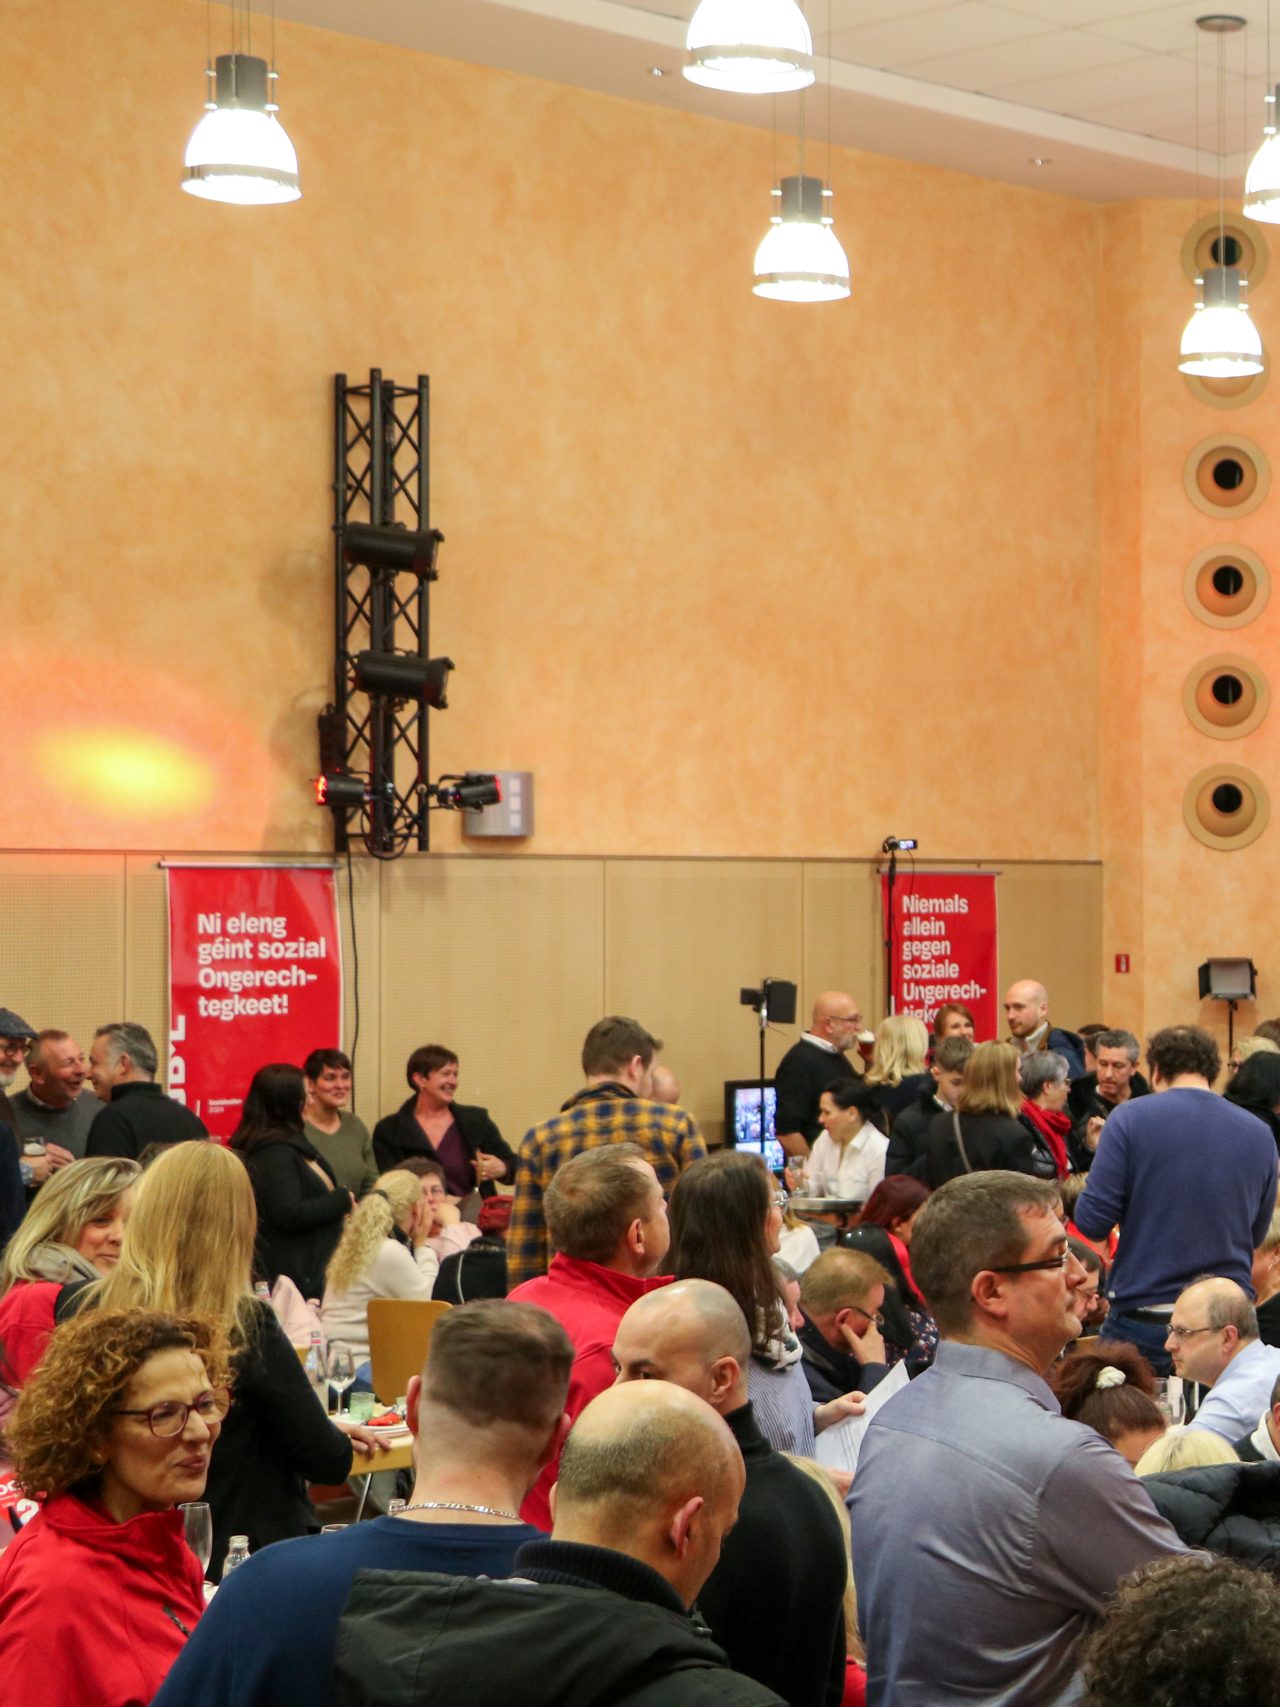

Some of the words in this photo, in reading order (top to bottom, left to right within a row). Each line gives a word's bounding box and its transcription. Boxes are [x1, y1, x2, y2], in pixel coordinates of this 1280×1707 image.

[902, 895, 968, 913] Niemals
[197, 912, 222, 935] Ni
[226, 912, 287, 939] eleng
[902, 916, 946, 936] allein
[197, 938, 253, 965] géint
[258, 937, 327, 960] sozial
[902, 939, 951, 961] gegen
[198, 965, 318, 992] Ongerech-
[902, 959, 959, 979] soziale
[902, 980, 986, 1005] Ungerech-
[199, 994, 289, 1020] tegkeet!
